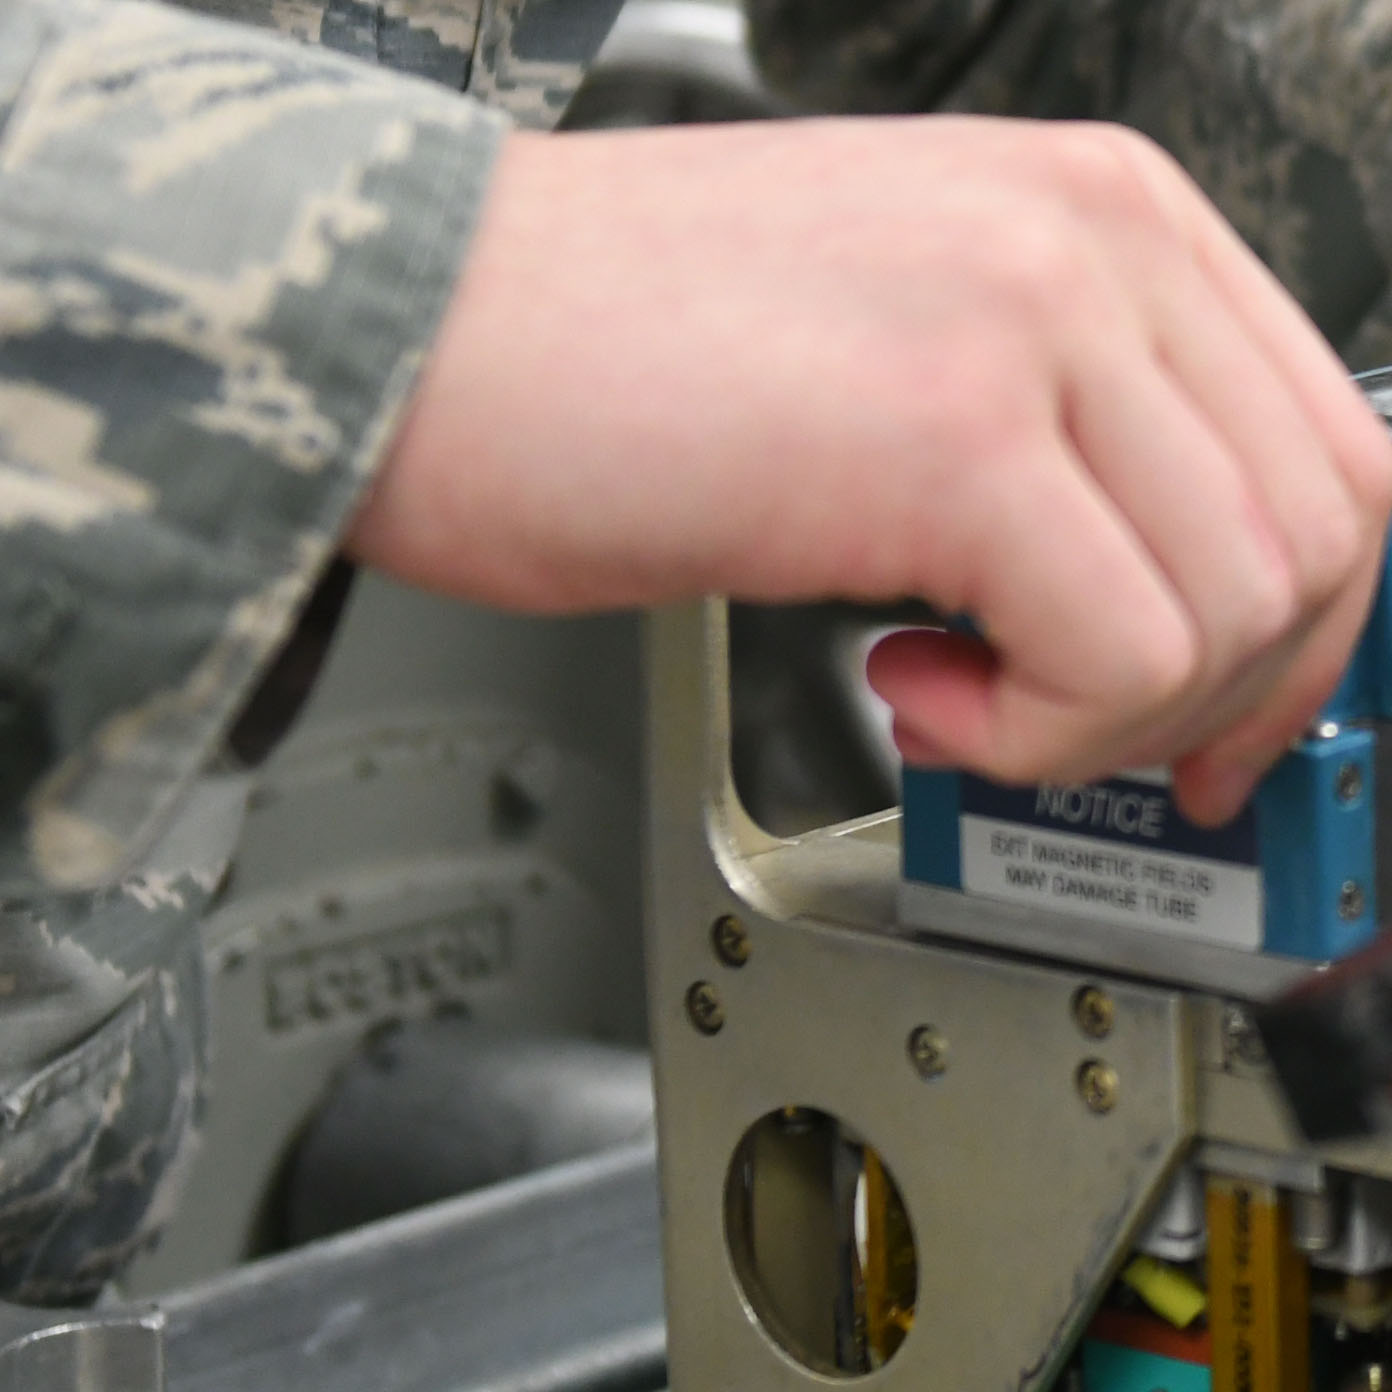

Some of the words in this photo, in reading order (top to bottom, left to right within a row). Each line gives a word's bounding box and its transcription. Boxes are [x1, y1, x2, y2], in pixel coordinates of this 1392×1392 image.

[1035, 783, 1167, 839] NOTICE
[1032, 838, 1135, 880] MAGNETIC
[1052, 873, 1137, 910] DAMAGE
